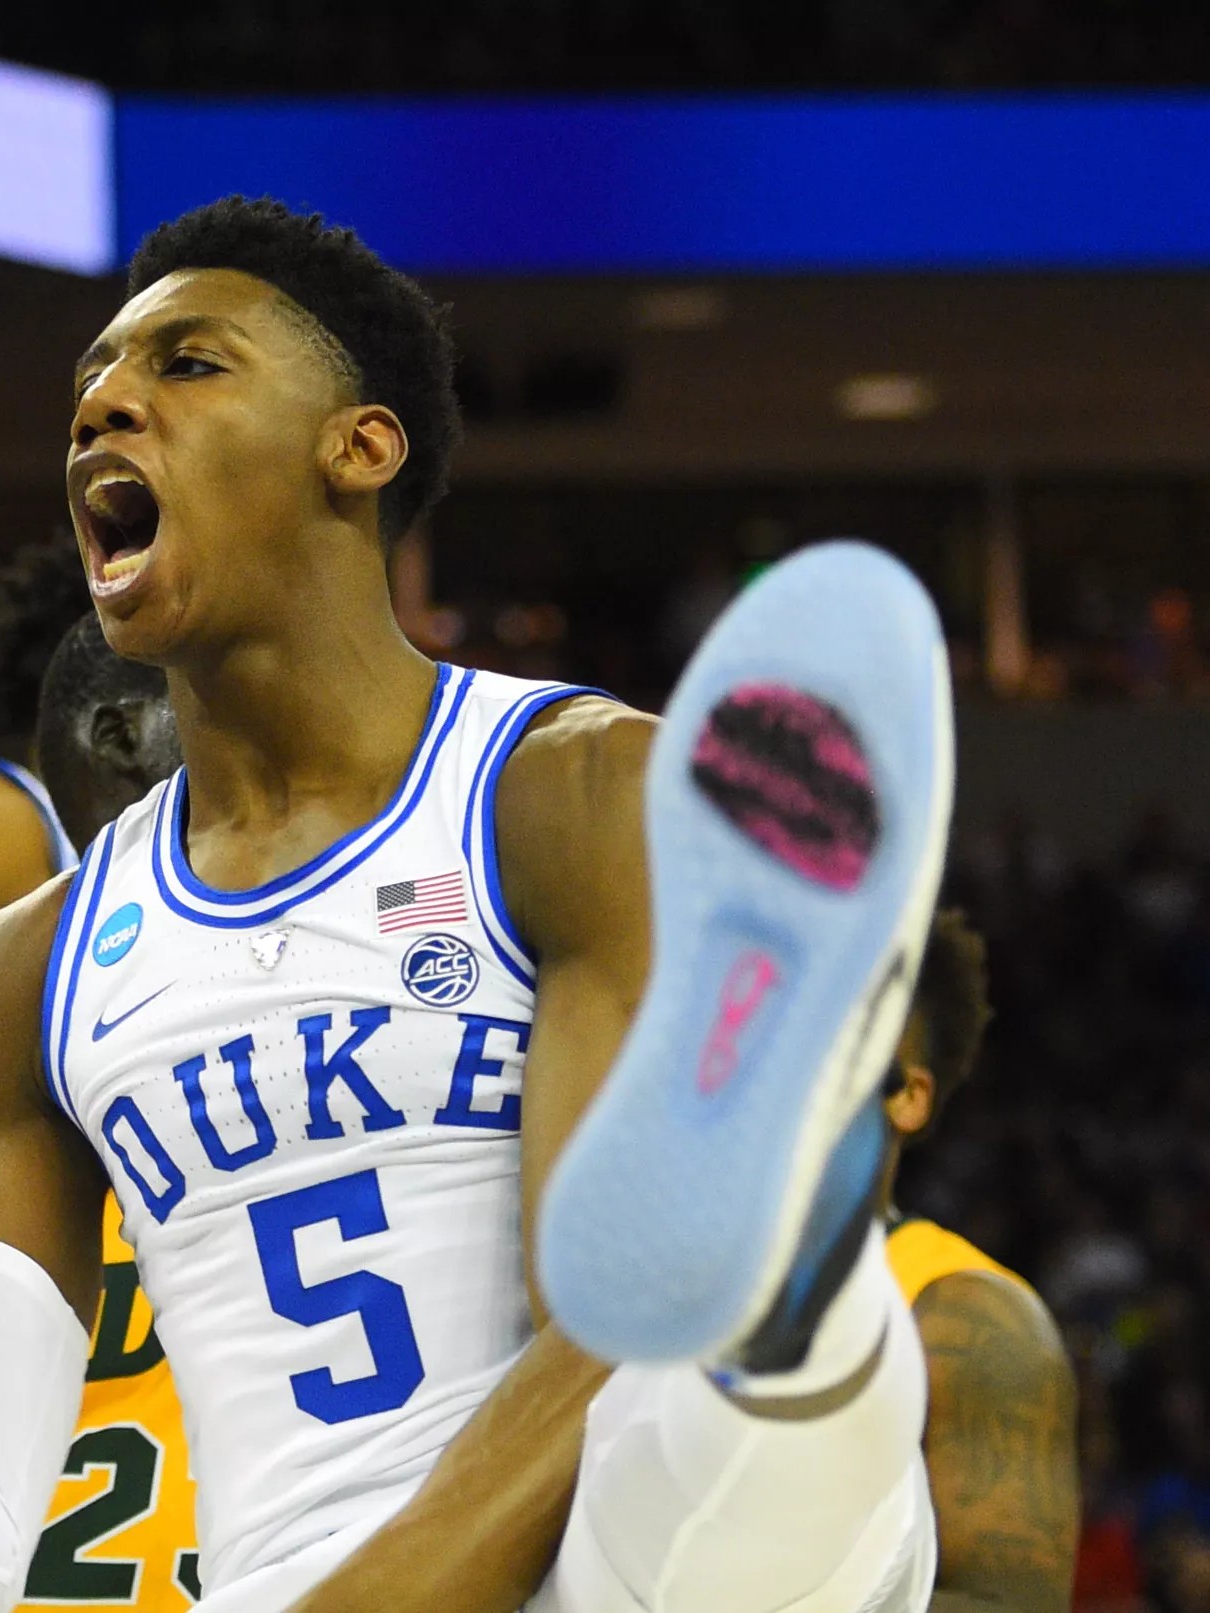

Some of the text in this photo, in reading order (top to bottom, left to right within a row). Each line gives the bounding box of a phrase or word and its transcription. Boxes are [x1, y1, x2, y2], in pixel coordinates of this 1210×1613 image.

[413, 952, 471, 979] ACC
[102, 1005, 532, 1224] DUKE
[248, 1168, 425, 1425] 5
